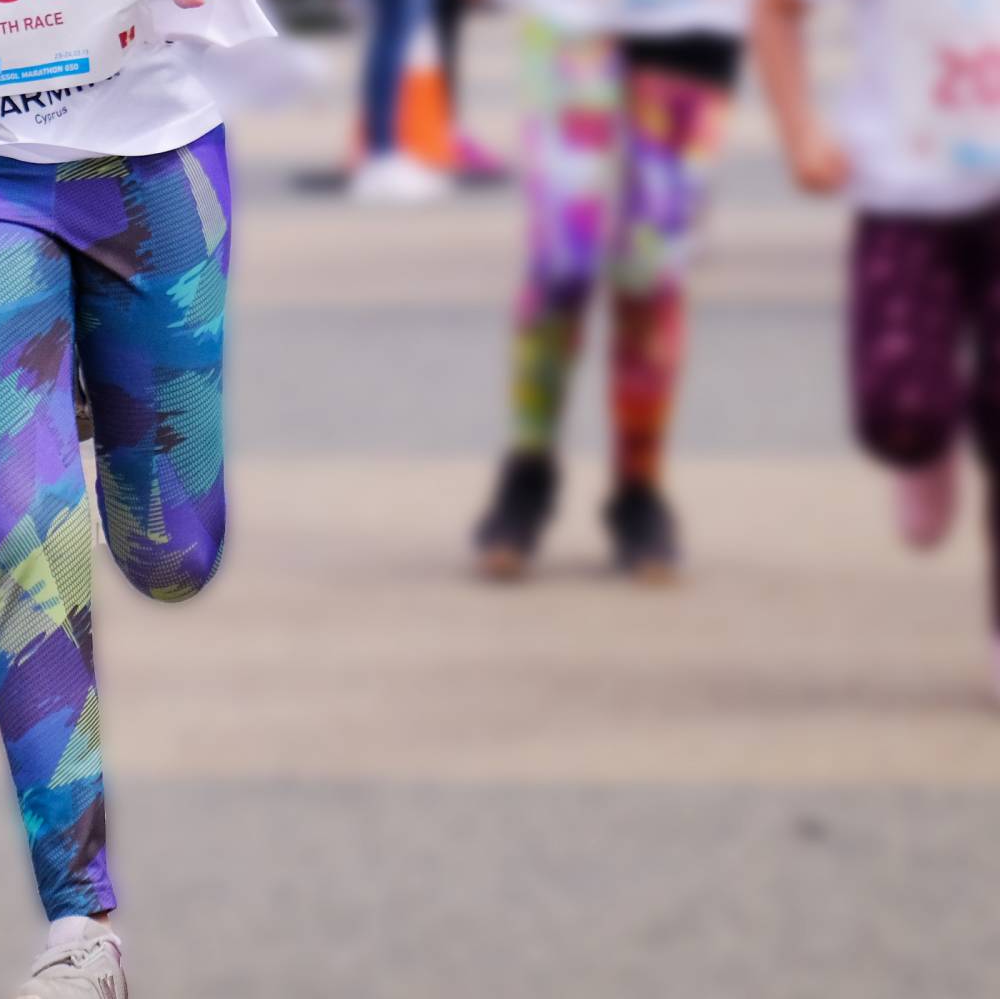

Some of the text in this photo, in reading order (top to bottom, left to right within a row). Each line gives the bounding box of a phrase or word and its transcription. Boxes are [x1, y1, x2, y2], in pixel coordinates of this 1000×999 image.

[22, 12, 65, 30] RACE
[21, 64, 63, 79] MARATHON
[34, 105, 68, 125] Cyprus
